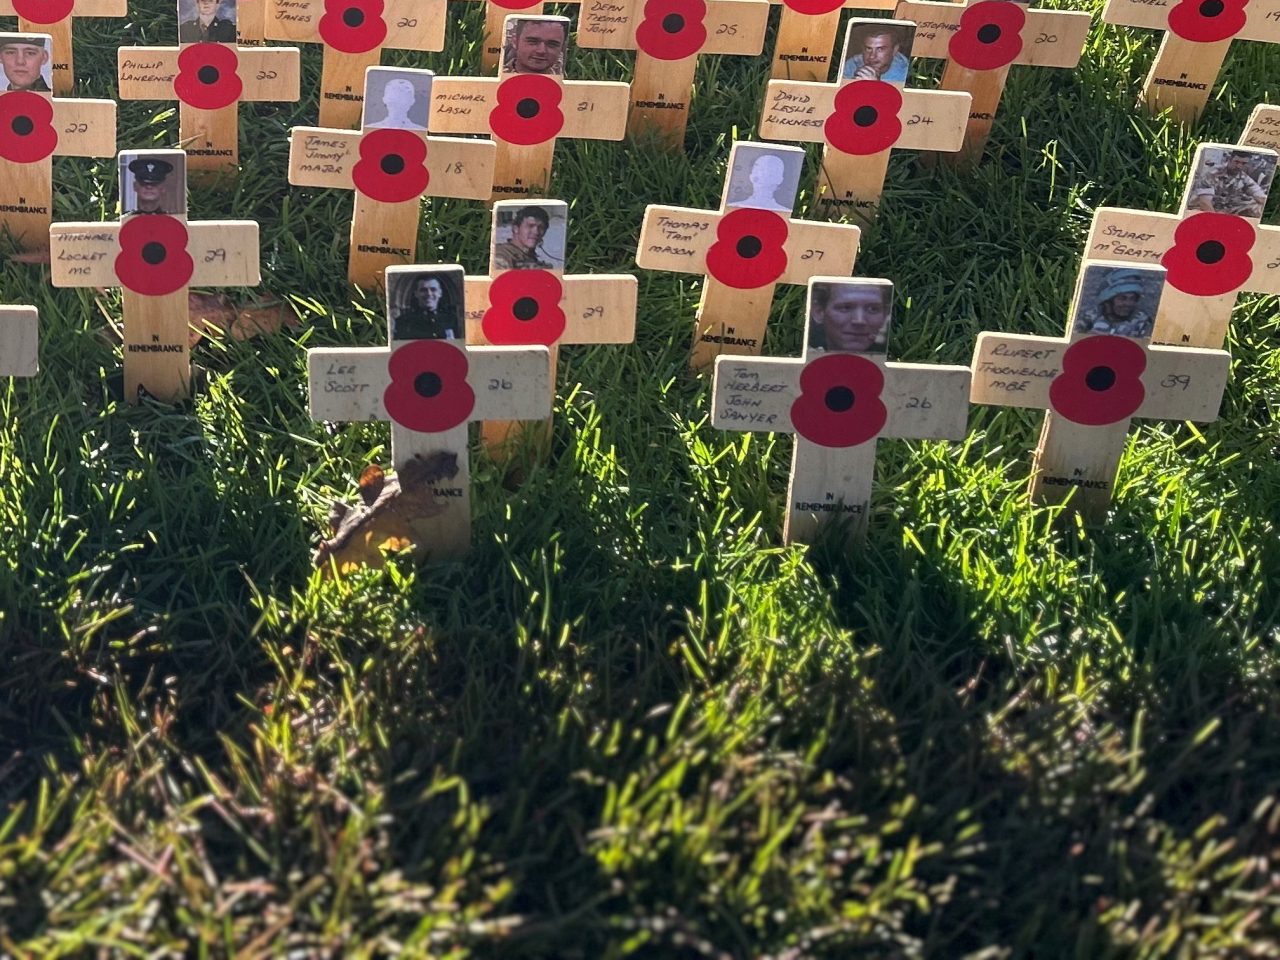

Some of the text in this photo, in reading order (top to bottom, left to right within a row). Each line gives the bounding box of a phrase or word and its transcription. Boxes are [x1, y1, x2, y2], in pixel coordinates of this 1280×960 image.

[591, 1, 625, 12] DEAN
[275, 10, 311, 22] JANES
[588, 13, 627, 23] THOMAS
[396, 17, 417, 28] 20
[586, 22, 616, 35] JOHN
[716, 24, 737, 36] 25
[1035, 33, 1057, 44] 20
[780, 54, 827, 64] REMEMBRANCE
[122, 60, 162, 70] PHILLIP
[256, 71, 277, 81] 22
[1154, 78, 1207, 90] REMEMBRANCE
[436, 93, 486, 103] MICHAEL
[774, 90, 810, 104] DAVID
[438, 106, 471, 114] LASKI
[578, 102, 594, 111] 21
[636, 101, 685, 110] REMEMBRANCE
[771, 104, 816, 114] LESLIE
[765, 116, 824, 128] KIRKNESS
[906, 115, 934, 125] 24
[65, 123, 87, 133] 22
[305, 137, 347, 150] JAMES
[300, 164, 343, 175] MAJOR
[445, 163, 463, 174] 18
[19, 197, 26, 205] IN
[657, 216, 709, 230] THOMAS
[1103, 225, 1155, 241] STUART
[57, 251, 107, 261] LOCKET
[205, 249, 225, 263] 29
[358, 245, 411, 256] REMEMBRANCE
[648, 245, 695, 257] MASON
[801, 250, 824, 261] 27
[69, 266, 90, 275] MC
[583, 306, 604, 318] 29
[727, 327, 735, 335] IN
[152, 334, 159, 342] IN
[128, 344, 183, 353] REMEMBRANCE
[991, 343, 1056, 358] RUPERT
[327, 365, 356, 375] LEE
[324, 380, 369, 393] SCOTT
[488, 378, 512, 391] 26
[723, 381, 788, 394] HERBERT
[989, 380, 1030, 392] MBE
[1161, 374, 1191, 391] 39
[725, 395, 762, 407] JOHN
[905, 396, 932, 409] 26
[719, 408, 777, 423] SAWYER
[826, 492, 834, 500] IN
